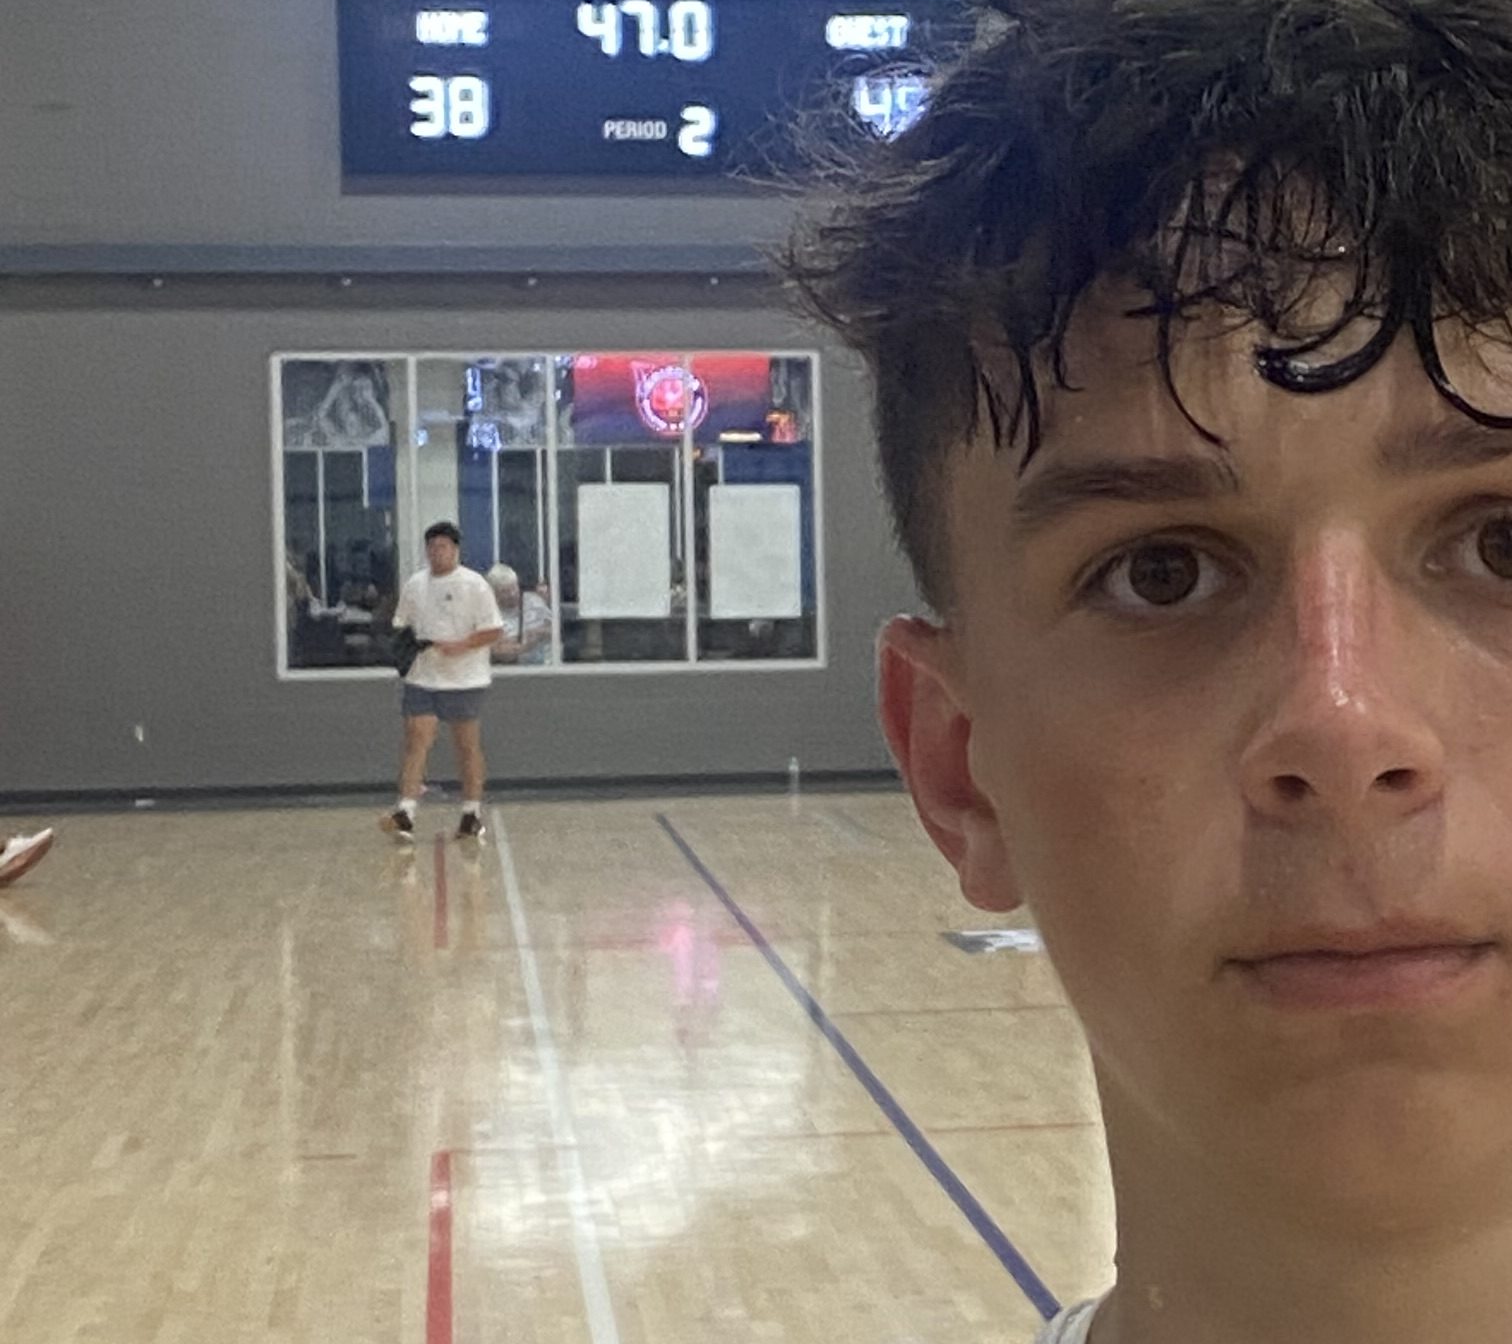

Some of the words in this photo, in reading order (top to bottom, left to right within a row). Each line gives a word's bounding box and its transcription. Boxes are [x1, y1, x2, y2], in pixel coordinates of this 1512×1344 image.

[577, 0, 713, 61] 47.0
[408, 75, 490, 139] 38
[603, 119, 668, 140] PERIOD
[678, 105, 716, 156] 2
